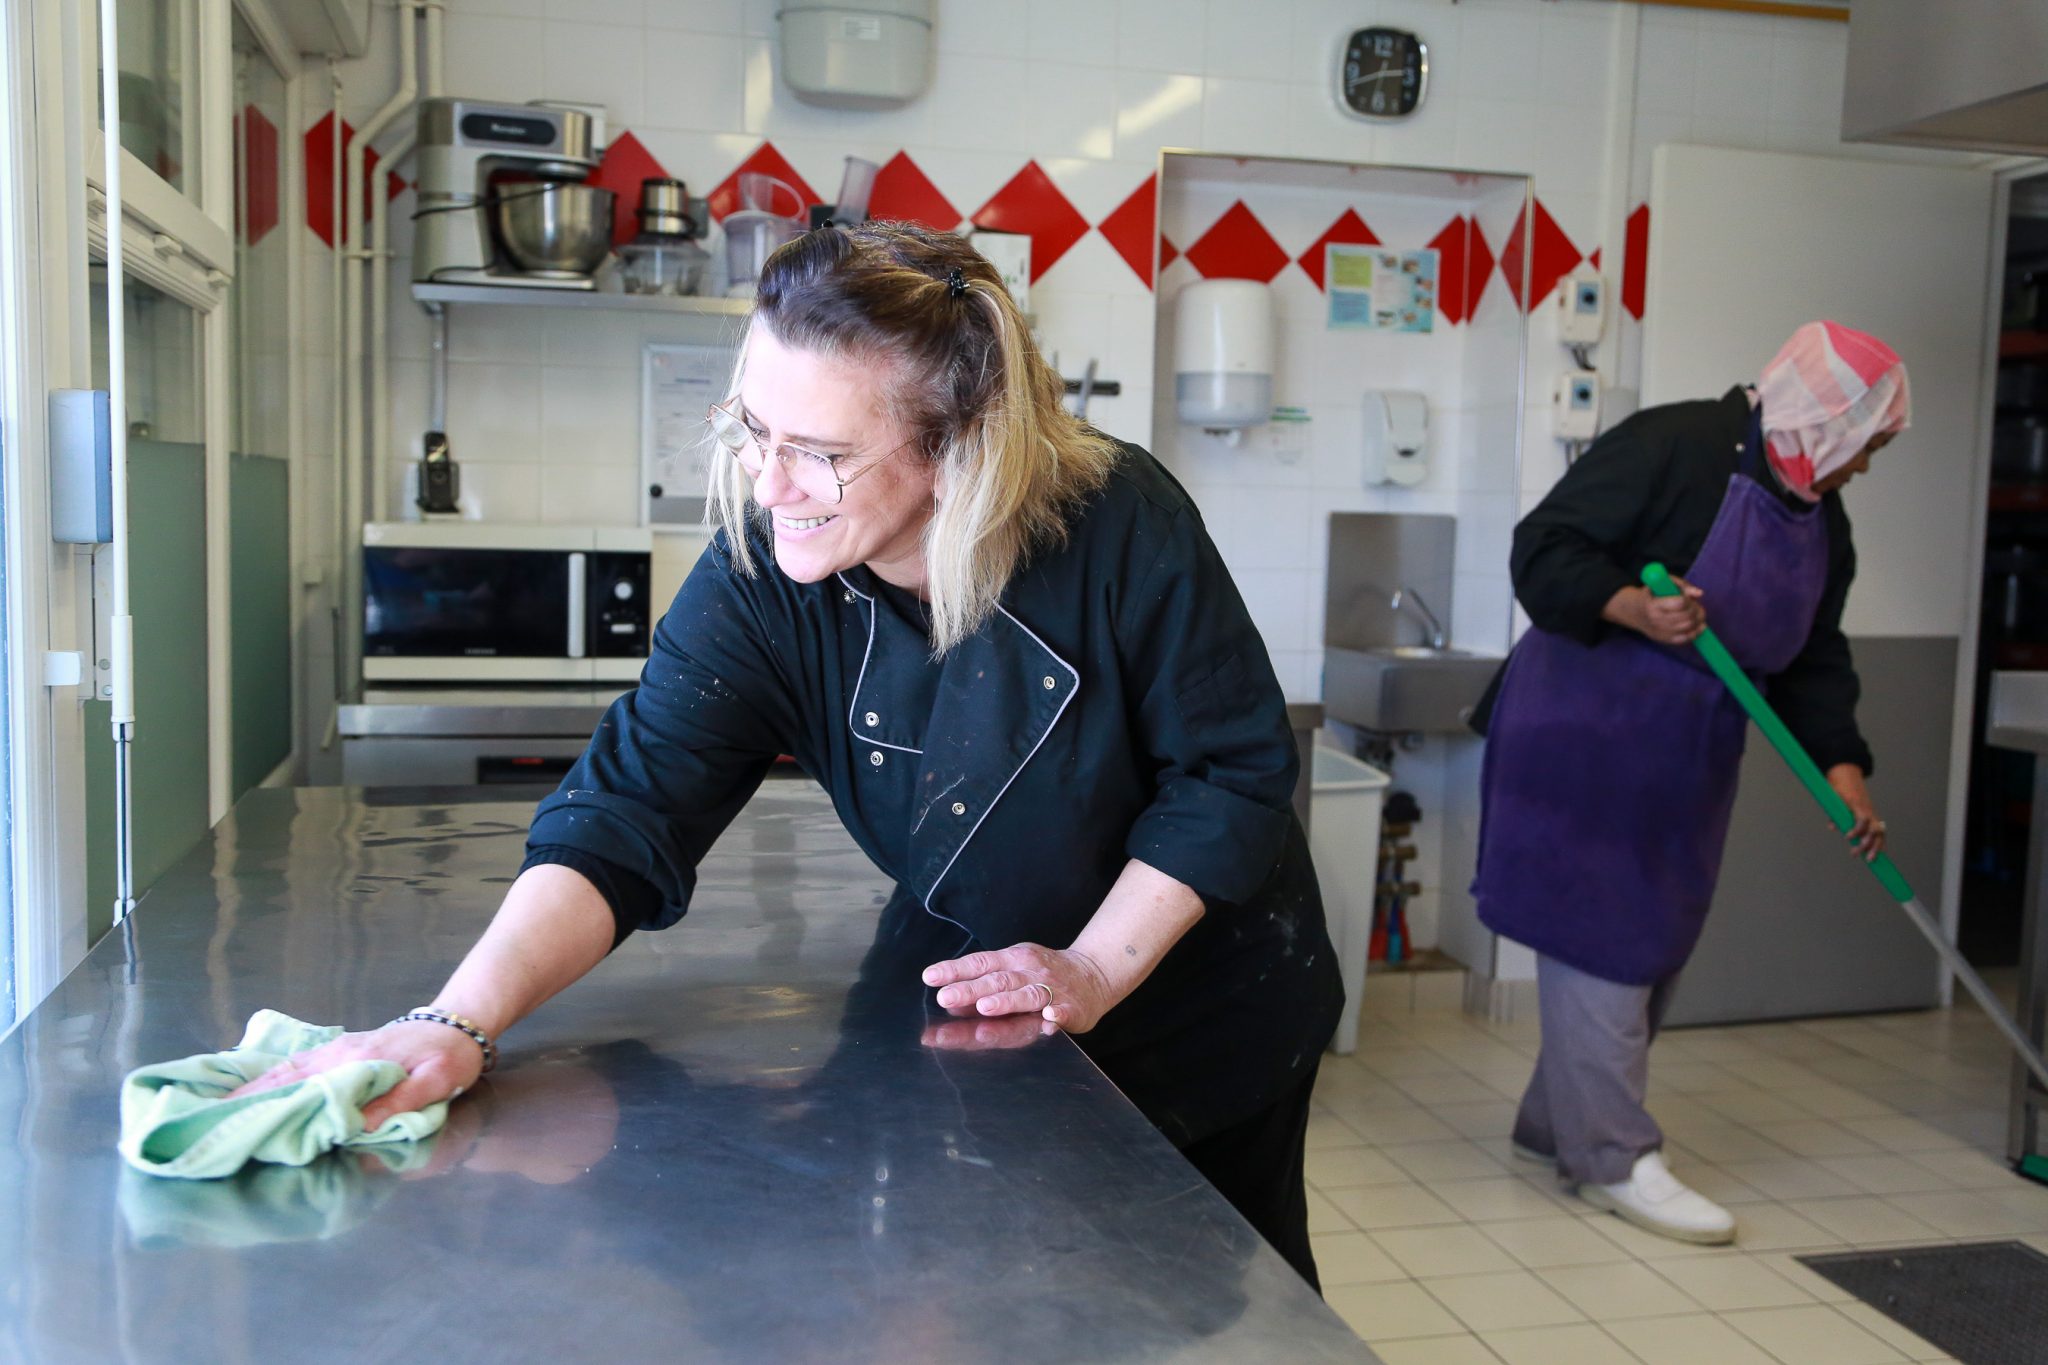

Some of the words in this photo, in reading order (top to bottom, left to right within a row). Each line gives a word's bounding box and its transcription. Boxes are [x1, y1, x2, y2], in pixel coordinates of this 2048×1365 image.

[1374, 35, 1393, 58] 12
[1402, 67, 1415, 87] 3
[1372, 90, 1386, 112] 6
